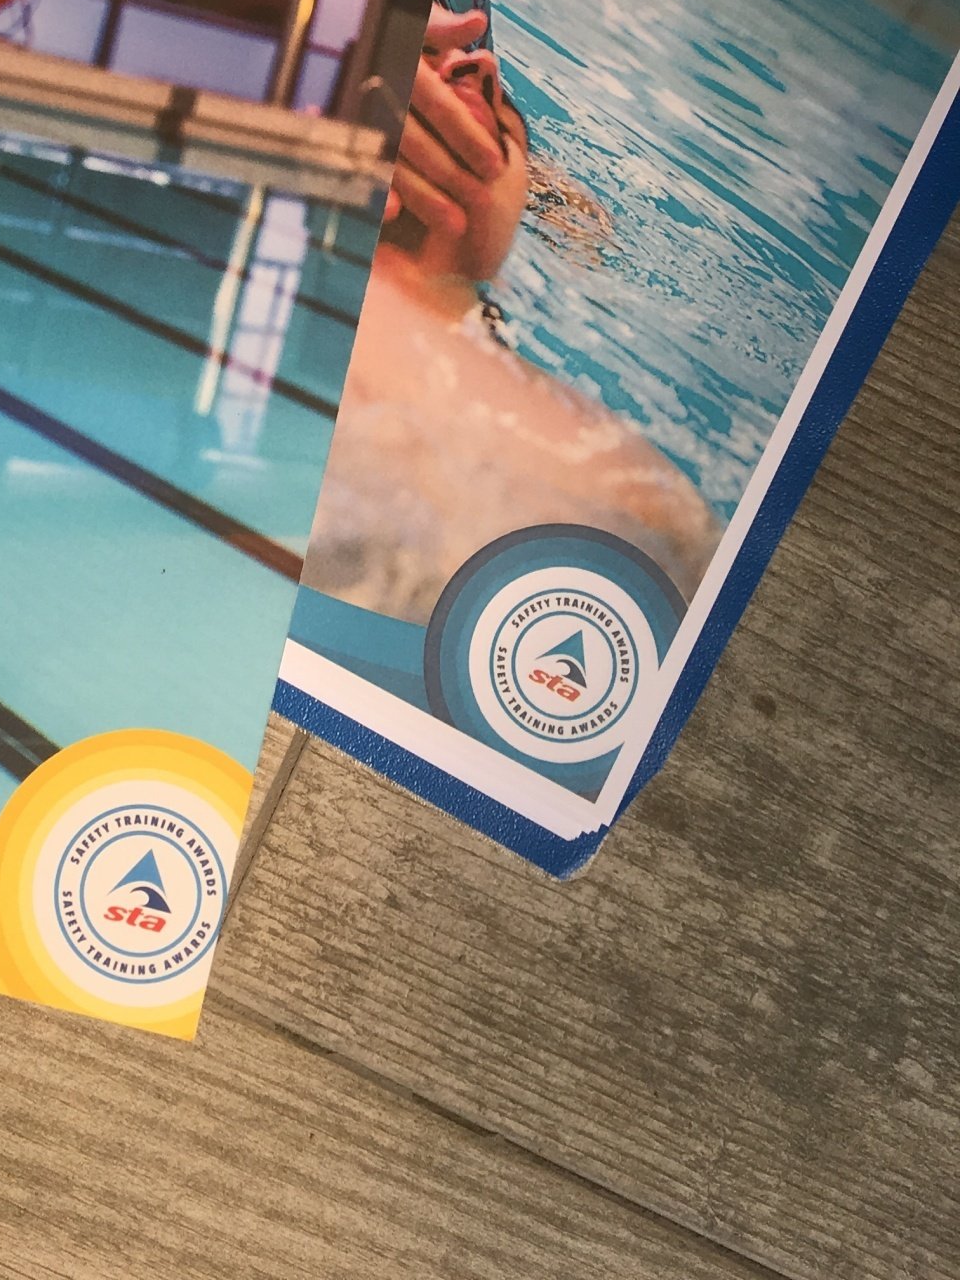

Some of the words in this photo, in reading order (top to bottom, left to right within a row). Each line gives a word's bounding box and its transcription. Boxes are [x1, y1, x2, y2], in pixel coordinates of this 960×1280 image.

[511, 598, 550, 628] SAFETY
[555, 597, 613, 628] TRAINING
[611, 630, 630, 683] AWARDS
[497, 646, 511, 694] SAFETY
[508, 697, 564, 735] TRAINING
[571, 701, 618, 735] AWARDS
[528, 669, 581, 702] sta
[70, 823, 110, 865] SAFETY
[115, 814, 185, 839] TRAINING
[186, 838, 217, 896] AWARDS
[62, 891, 87, 943] SAFETY
[87, 945, 157, 975] TRAINING
[164, 921, 211, 970] AWARDS
[103, 906, 167, 933] sta
